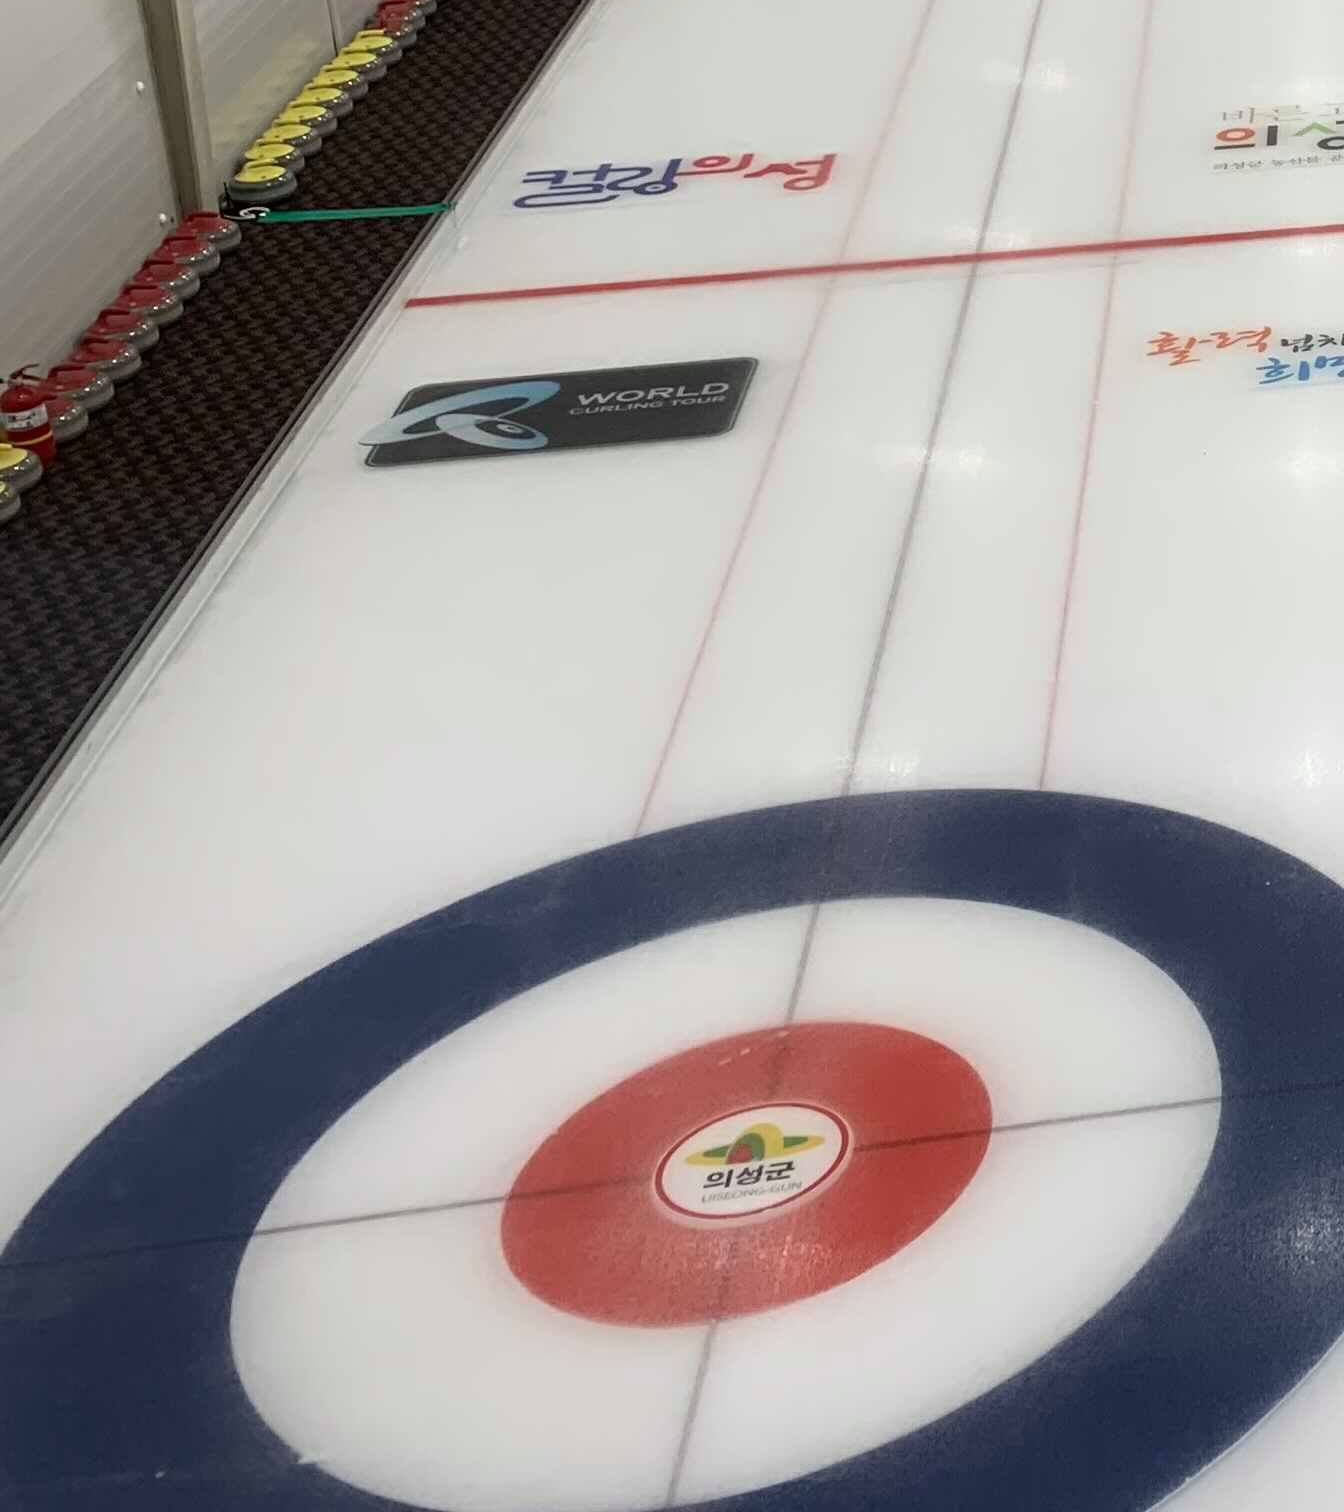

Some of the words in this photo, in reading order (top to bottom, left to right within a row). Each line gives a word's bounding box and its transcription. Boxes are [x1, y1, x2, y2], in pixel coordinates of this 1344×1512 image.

[569, 400, 665, 415] CURLING
[669, 394, 728, 406] TOUR
[577, 382, 730, 406] WORLD
[703, 1160, 796, 1189] 의성군
